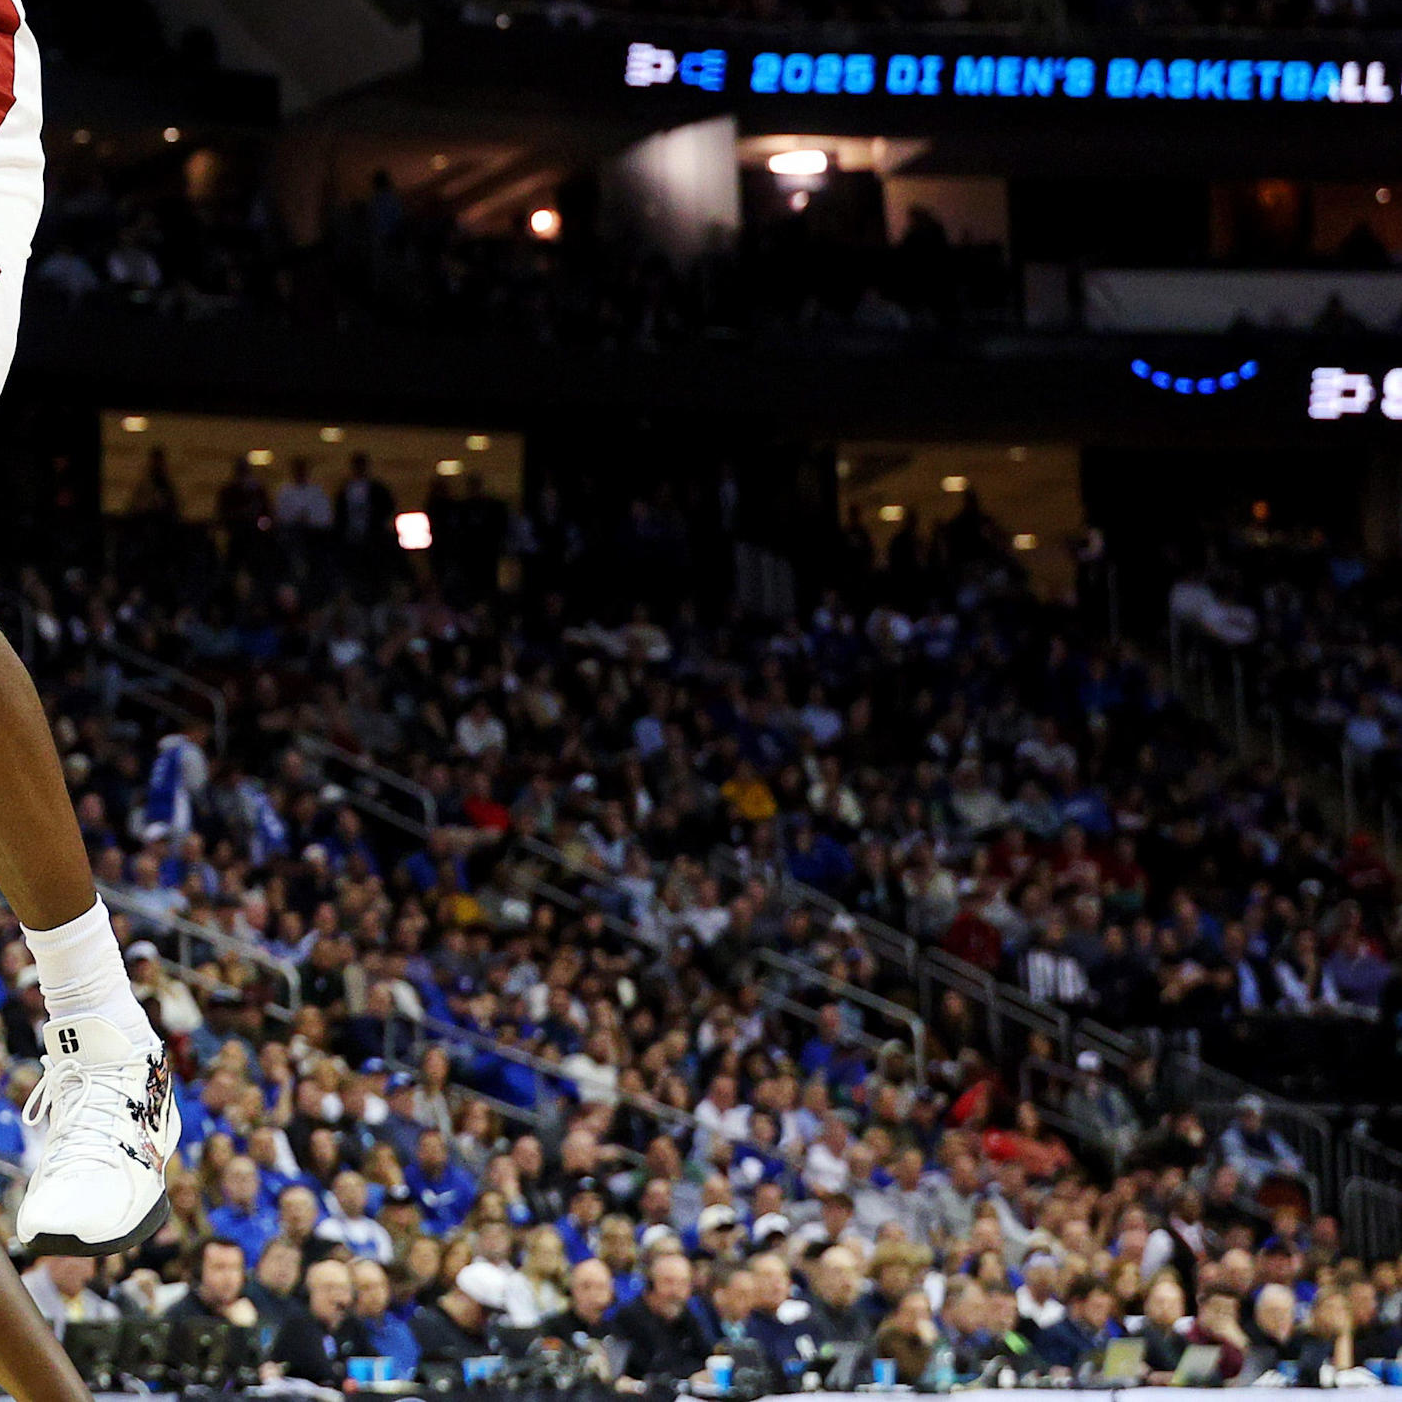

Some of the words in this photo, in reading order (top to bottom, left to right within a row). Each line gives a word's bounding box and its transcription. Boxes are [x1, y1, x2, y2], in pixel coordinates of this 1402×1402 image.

[749, 51, 876, 95] 2025
[952, 54, 1096, 98] MEN'S
[1105, 56, 1395, 104] BASKETBALL
